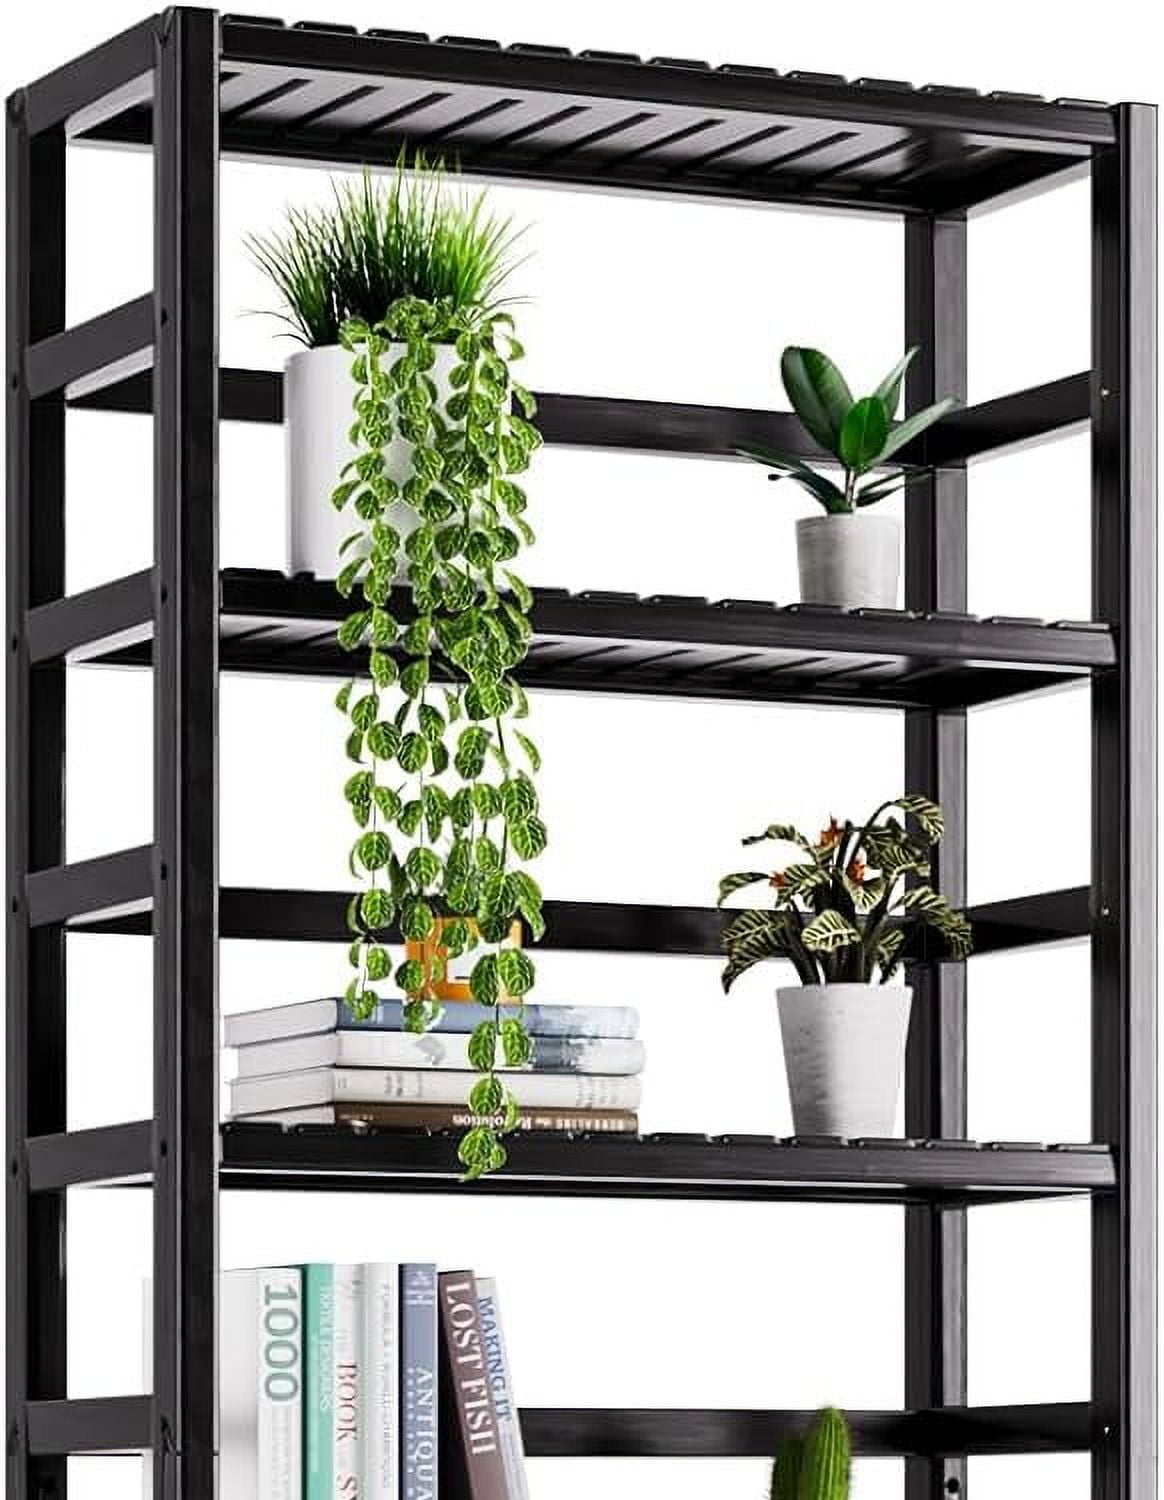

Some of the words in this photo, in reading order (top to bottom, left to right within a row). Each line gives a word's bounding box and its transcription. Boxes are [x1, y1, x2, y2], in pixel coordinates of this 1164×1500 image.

[264, 1284, 299, 1402] 1000
[445, 1282, 482, 1369] LOST
[478, 1297, 506, 1392] MAKING
[494, 1399, 512, 1422] IT
[336, 1363, 359, 1441] BOOK
[461, 1378, 497, 1455] FISH
